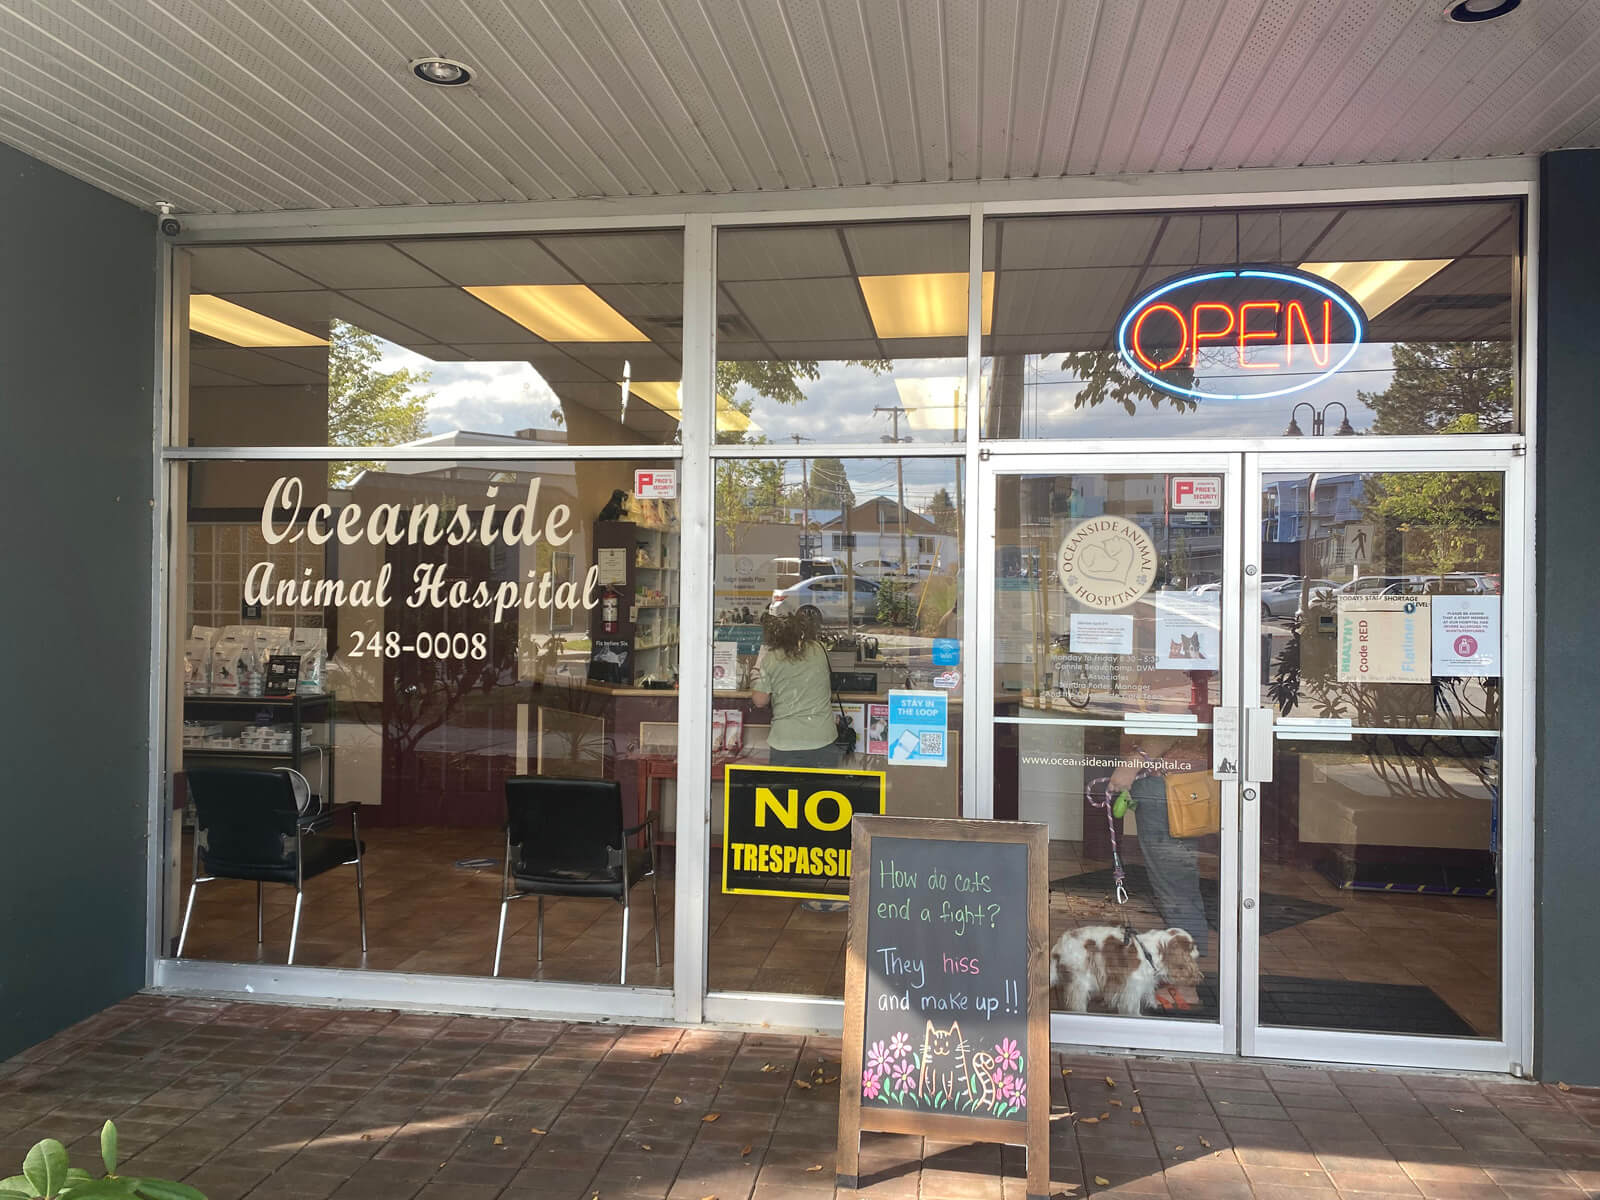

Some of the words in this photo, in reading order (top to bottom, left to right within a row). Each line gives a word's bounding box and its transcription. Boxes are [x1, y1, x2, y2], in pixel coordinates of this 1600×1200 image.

[1132, 300, 1333, 370] OPEN
[261, 477, 574, 546] Oceanside
[1063, 520, 1119, 573] OCEANSIDE
[1120, 525, 1152, 573] ANIMAL
[243, 561, 391, 609] Animal
[406, 562, 600, 623] Hospital
[1075, 585, 1140, 606] HOSPITAL
[348, 630, 487, 660] 248-0008
[1359, 620, 1369, 642] RED
[1094, 655, 1118, 664] Friday
[1359, 645, 1369, 673] Code
[1115, 683, 1151, 692] Manager
[897, 708, 914, 716] THE
[916, 709, 939, 717] LOOP
[901, 699, 923, 707] STAY
[1021, 756, 1192, 771] www.oceansideanimalhospital.ca
[754, 787, 853, 832] NO
[880, 859, 917, 889] How
[928, 867, 946, 890] do
[954, 871, 992, 894] cats
[877, 898, 911, 921] end
[920, 908, 931, 922] a
[940, 900, 1001, 936] fight?
[876, 947, 926, 989] They
[942, 952, 981, 976] hiss
[878, 989, 910, 1012] and
